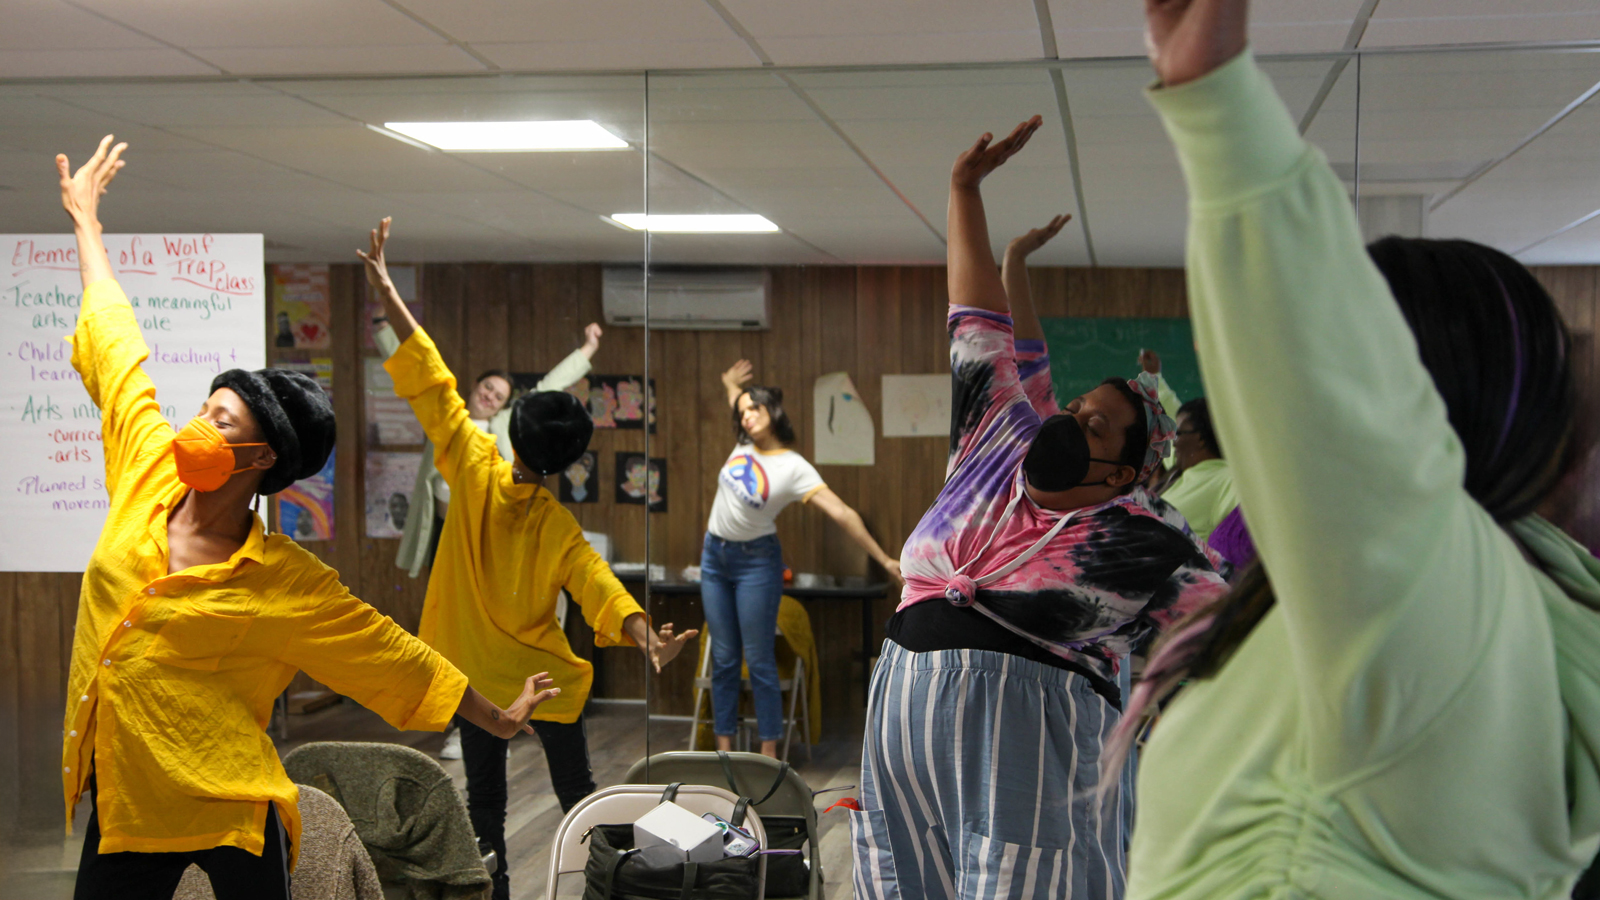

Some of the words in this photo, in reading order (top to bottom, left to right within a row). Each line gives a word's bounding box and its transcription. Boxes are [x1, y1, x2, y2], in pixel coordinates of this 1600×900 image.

[11, 239, 109, 267] Eleme
[119, 236, 142, 265] of
[142, 250, 155, 266] a
[163, 233, 214, 256] Wolf
[166, 258, 226, 282] Trap
[216, 272, 254, 290] class
[131, 296, 140, 308] a
[148, 292, 232, 319] meaningful
[32, 314, 67, 329] arts
[137, 314, 171, 331] ole
[18, 341, 63, 362] Child
[154, 344, 220, 373] teaching
[21, 394, 63, 424] Arts
[53, 429, 103, 443] curricu
[55, 445, 91, 463] arts
[20, 475, 86, 495] Planned
